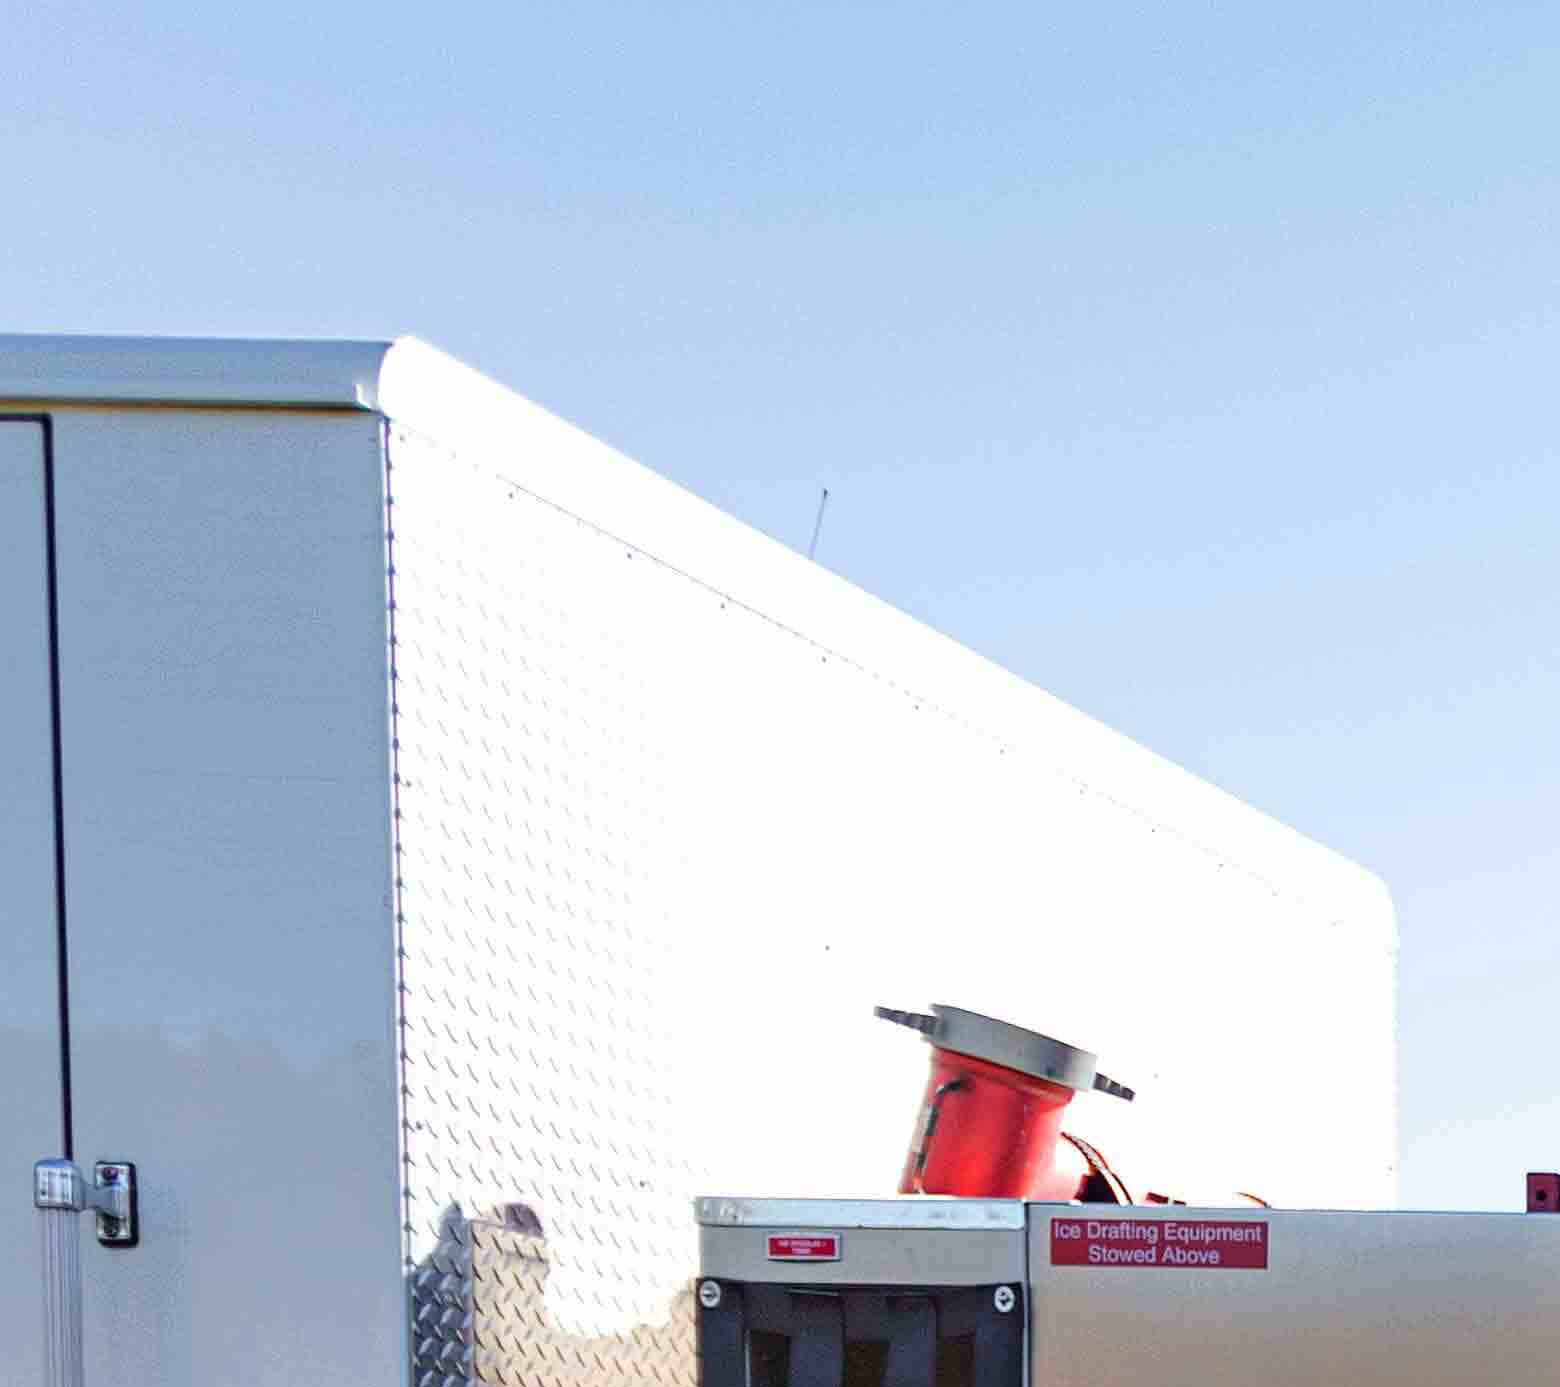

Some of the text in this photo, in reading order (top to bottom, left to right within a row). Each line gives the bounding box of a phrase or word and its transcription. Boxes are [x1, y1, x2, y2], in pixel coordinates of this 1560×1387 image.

[1055, 1222, 1262, 1243] Ice Drafting Equipment
[1088, 1245, 1220, 1264] Stowed Above
